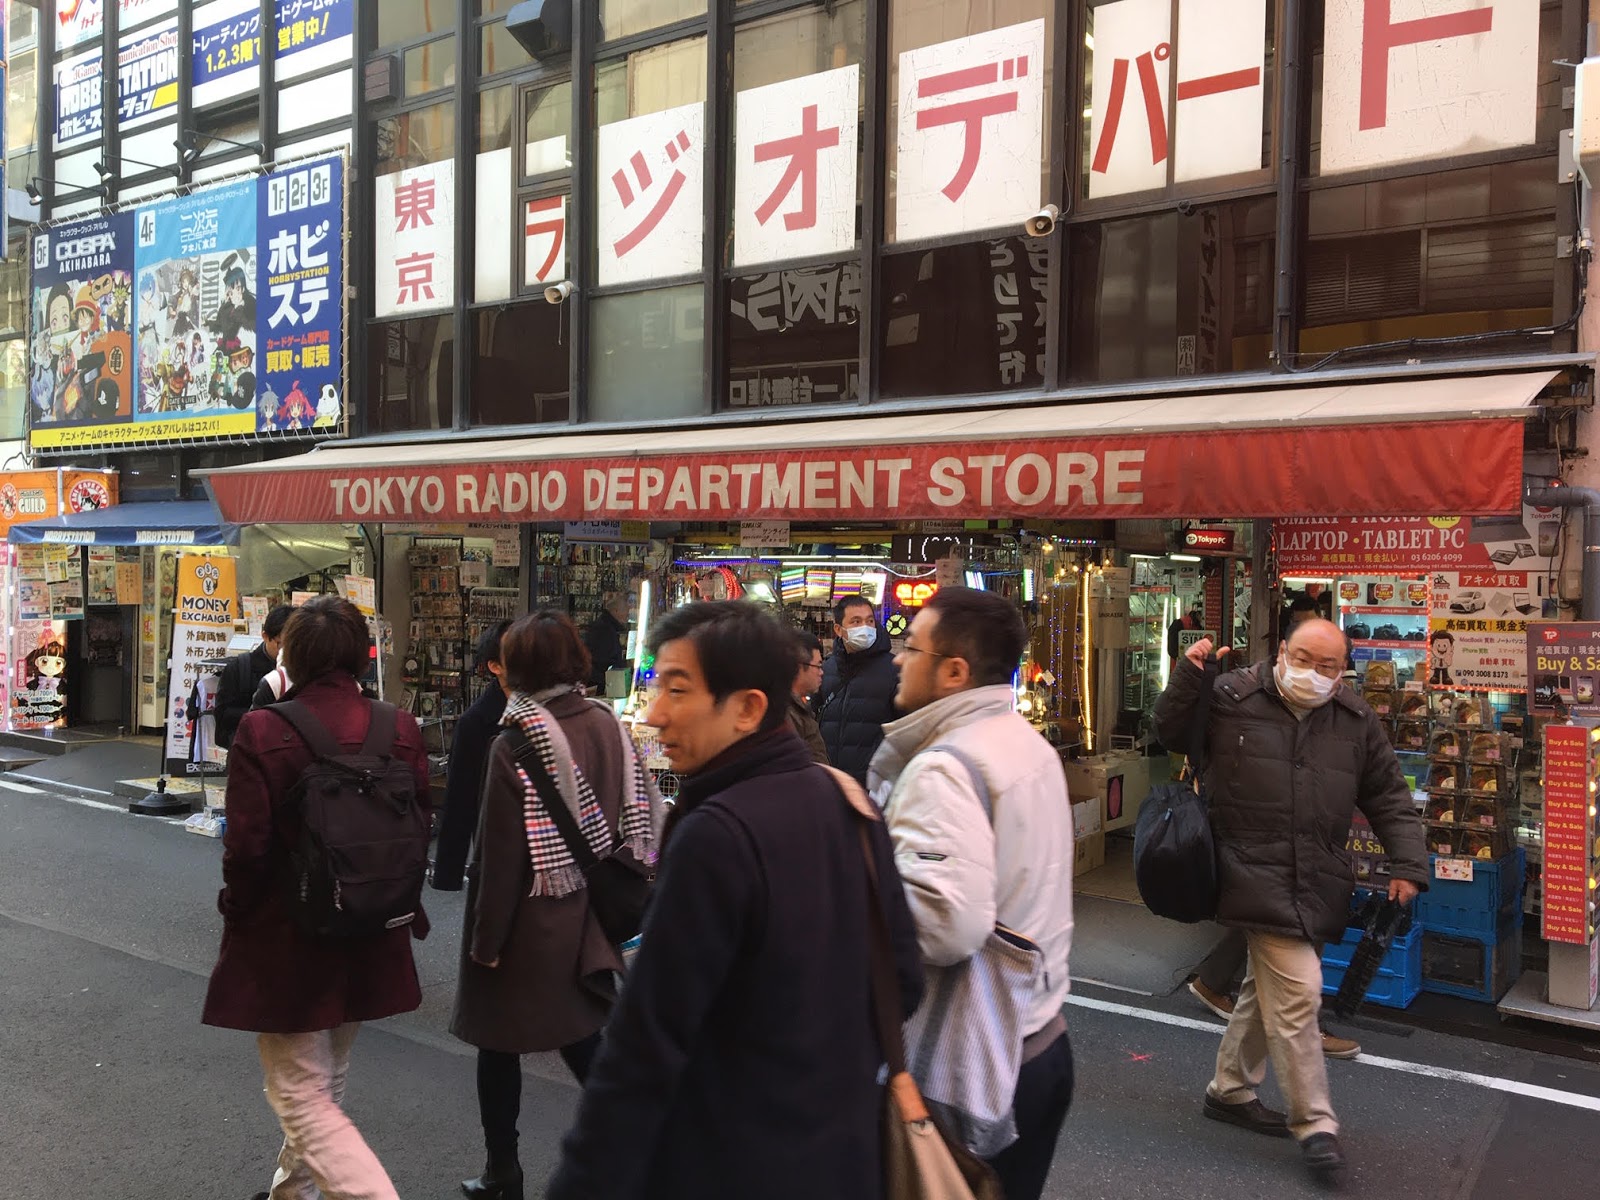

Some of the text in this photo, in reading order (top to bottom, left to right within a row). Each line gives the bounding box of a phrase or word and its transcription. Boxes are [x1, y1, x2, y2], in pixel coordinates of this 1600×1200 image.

[272, 172, 328, 211] 1F 2F 3F
[140, 215, 155, 243] 4F
[55, 231, 116, 262] COSPA
[394, 178, 436, 305] 東京
[36, 239, 47, 265] 5F
[59, 252, 111, 273] AKIHABARA
[268, 265, 330, 285] HOBBYSTATION
[330, 449, 1146, 516] TOKYO RADIO DEPARTMENT STORE
[19, 497, 46, 513] GUILD
[1198, 535, 1217, 544] Tokyo
[1280, 528, 1465, 550] LAPTOP TABLET PC
[1280, 555, 1292, 563] Buy
[1301, 554, 1316, 562] Sale
[1422, 553, 1441, 561] 6206
[1443, 554, 1463, 562] 4099
[1463, 574, 1520, 587] アキバ買取
[182, 596, 230, 612] MONEY
[1463, 669, 1474, 677] 090
[1537, 656, 1565, 674] Buy
[1570, 656, 1582, 671] &
[1548, 821, 1560, 829] Buy
[1547, 842, 1560, 850] Buy
[1569, 843, 1583, 851] Sale
[1547, 862, 1560, 870] Buy
[1547, 883, 1560, 891] Buy
[1547, 903, 1560, 911] Buy
[1568, 905, 1582, 913] Sale
[1568, 926, 1582, 934] Sale
